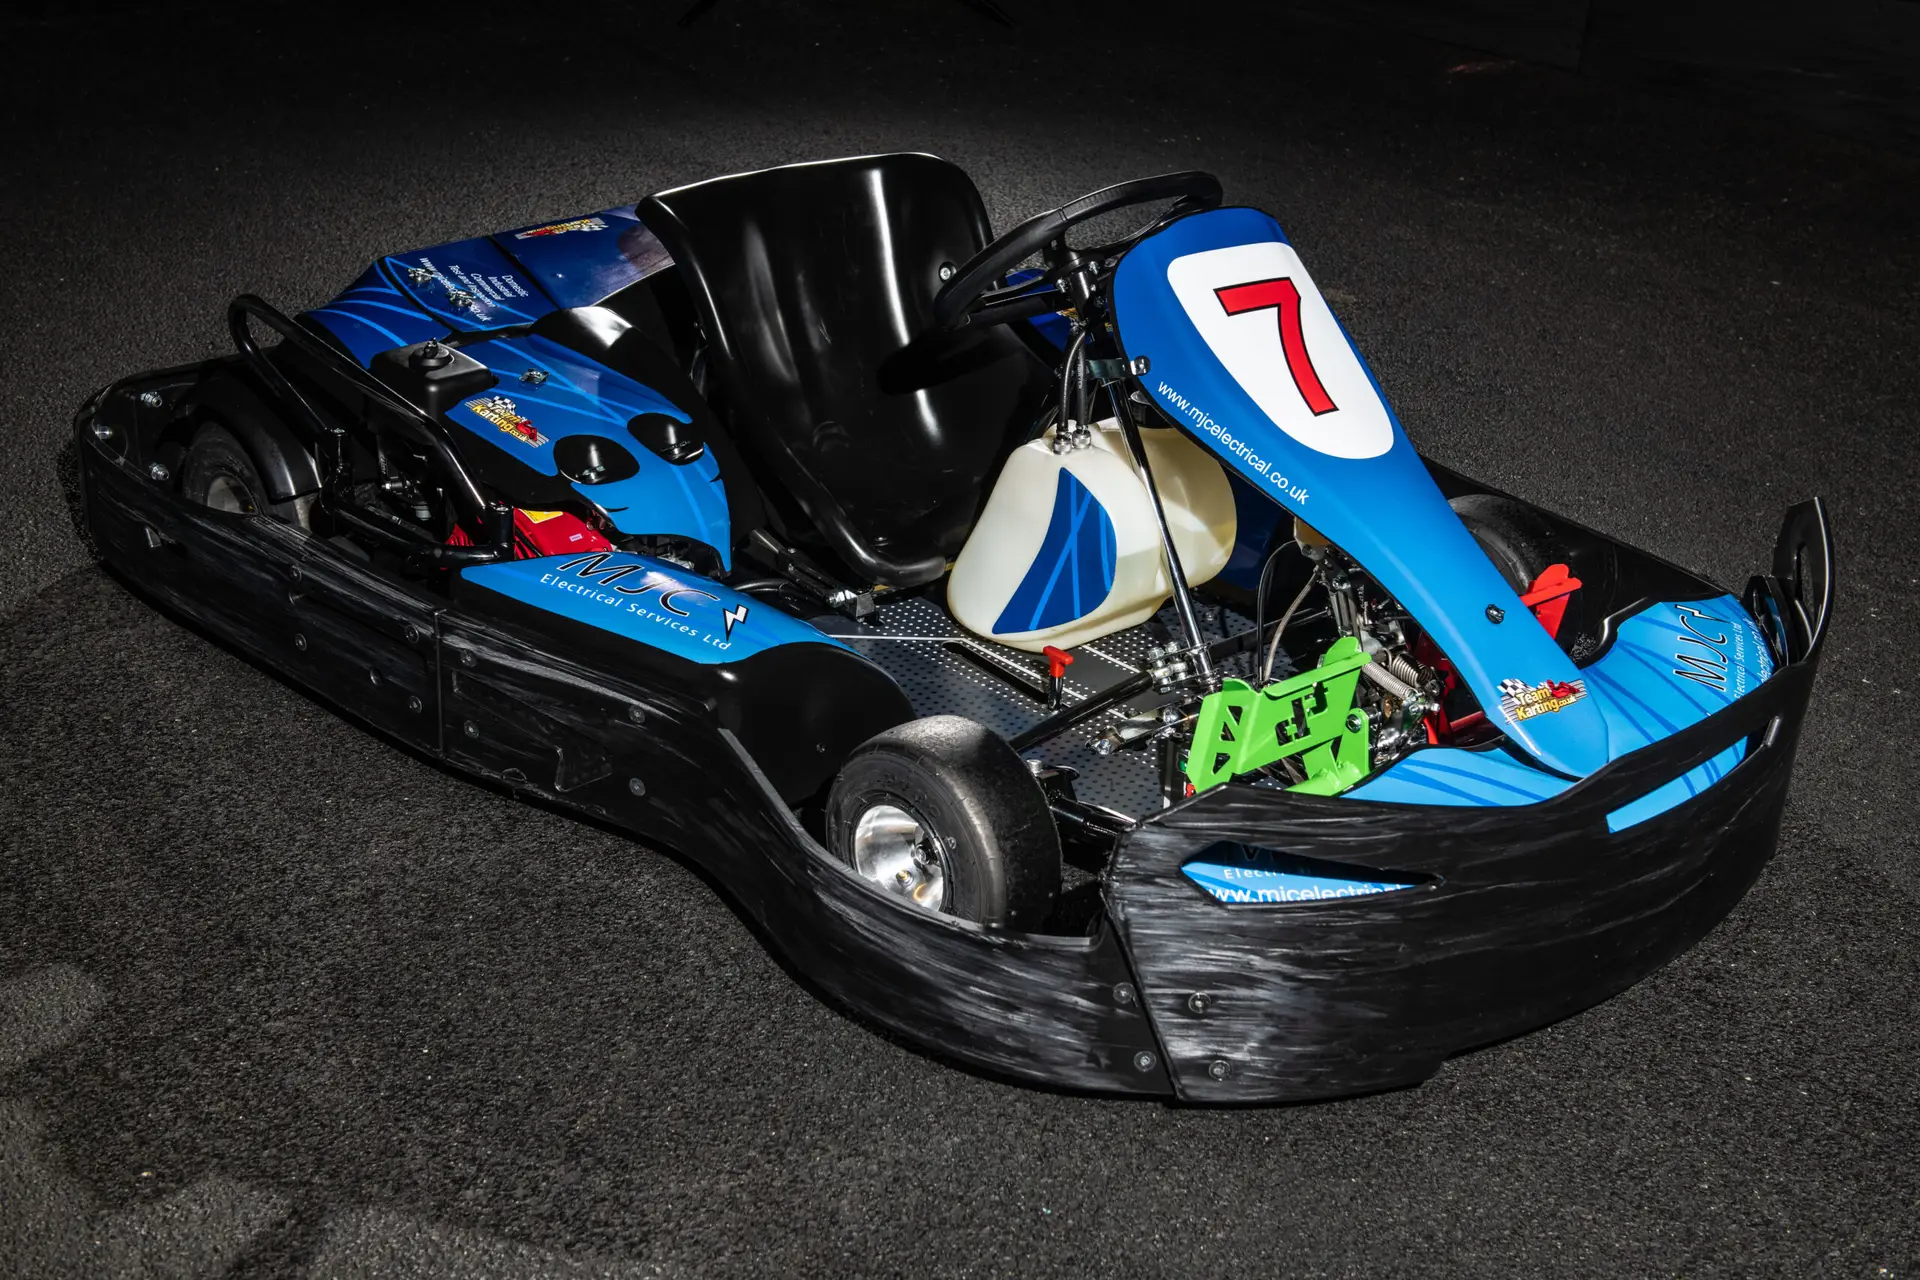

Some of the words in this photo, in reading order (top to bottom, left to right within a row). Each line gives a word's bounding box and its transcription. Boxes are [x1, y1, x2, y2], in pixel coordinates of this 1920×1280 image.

[1213, 276, 1340, 418] 7
[489, 403, 521, 424] Team
[1157, 381, 1310, 506] www.mjcelectrical.co.uk
[540, 573, 624, 608] Electrical
[626, 602, 700, 638] Services
[702, 633, 732, 651] Ltd
[556, 552, 721, 618] MJC
[1672, 613, 1728, 693] MJC
[1515, 686, 1551, 706] Team
